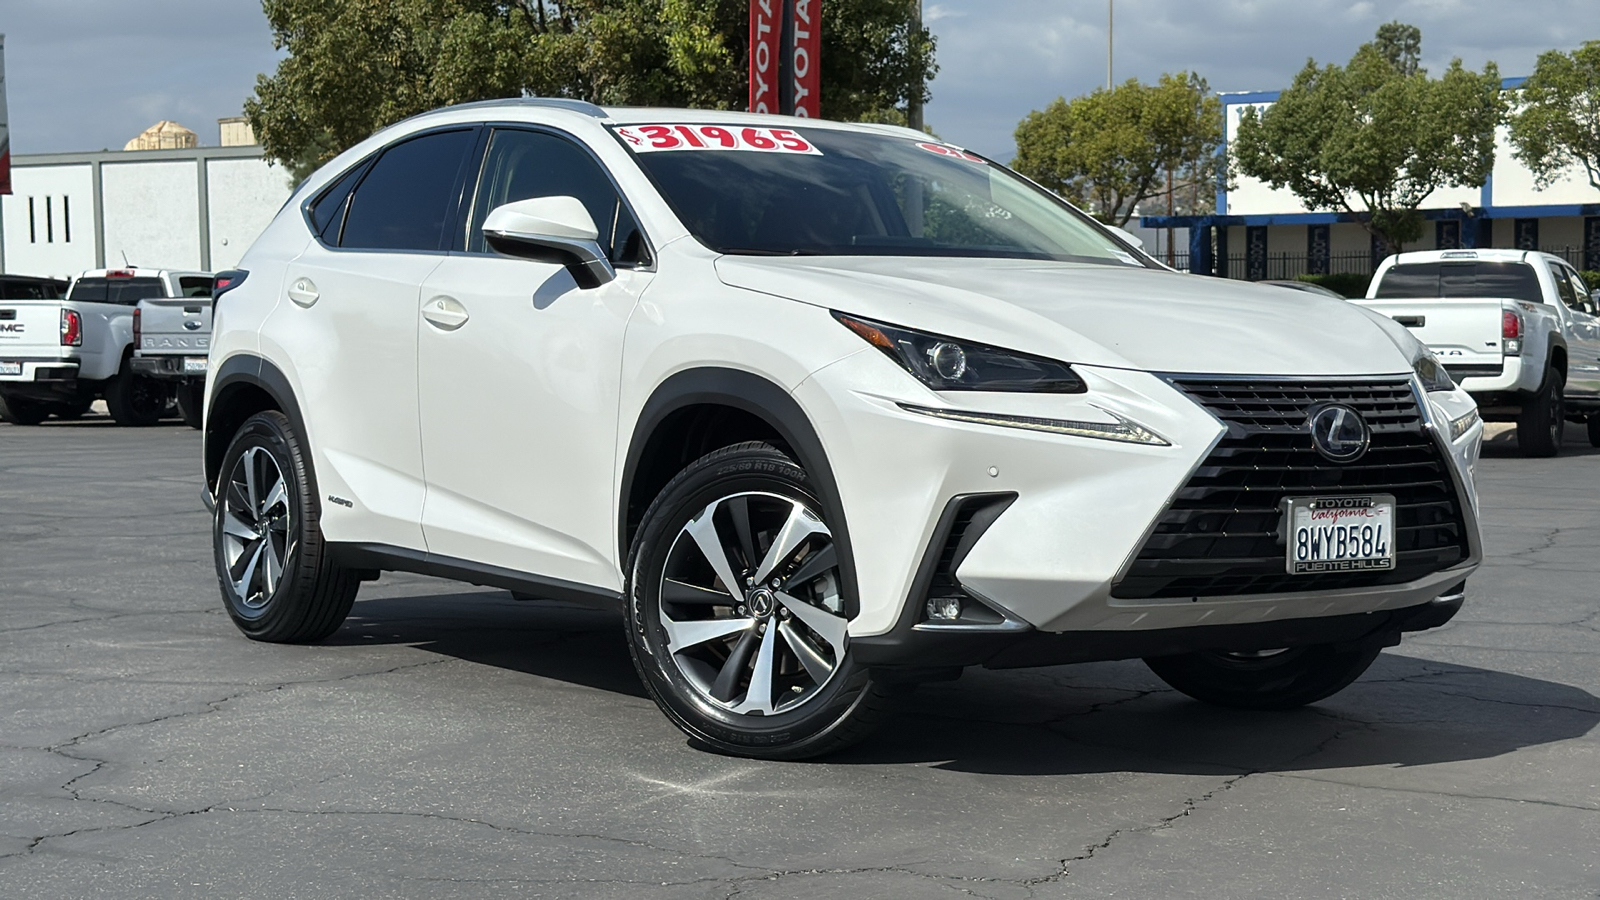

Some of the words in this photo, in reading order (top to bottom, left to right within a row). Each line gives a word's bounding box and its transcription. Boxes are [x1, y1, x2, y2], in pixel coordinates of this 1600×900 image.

[0, 324, 25, 332] MC
[1319, 498, 1370, 508] TOYOTA
[1311, 508, 1374, 524] California
[1297, 524, 1386, 560] 8WYB584
[1296, 562, 1349, 572] PUENTE
[1351, 559, 1390, 569] HILLS
